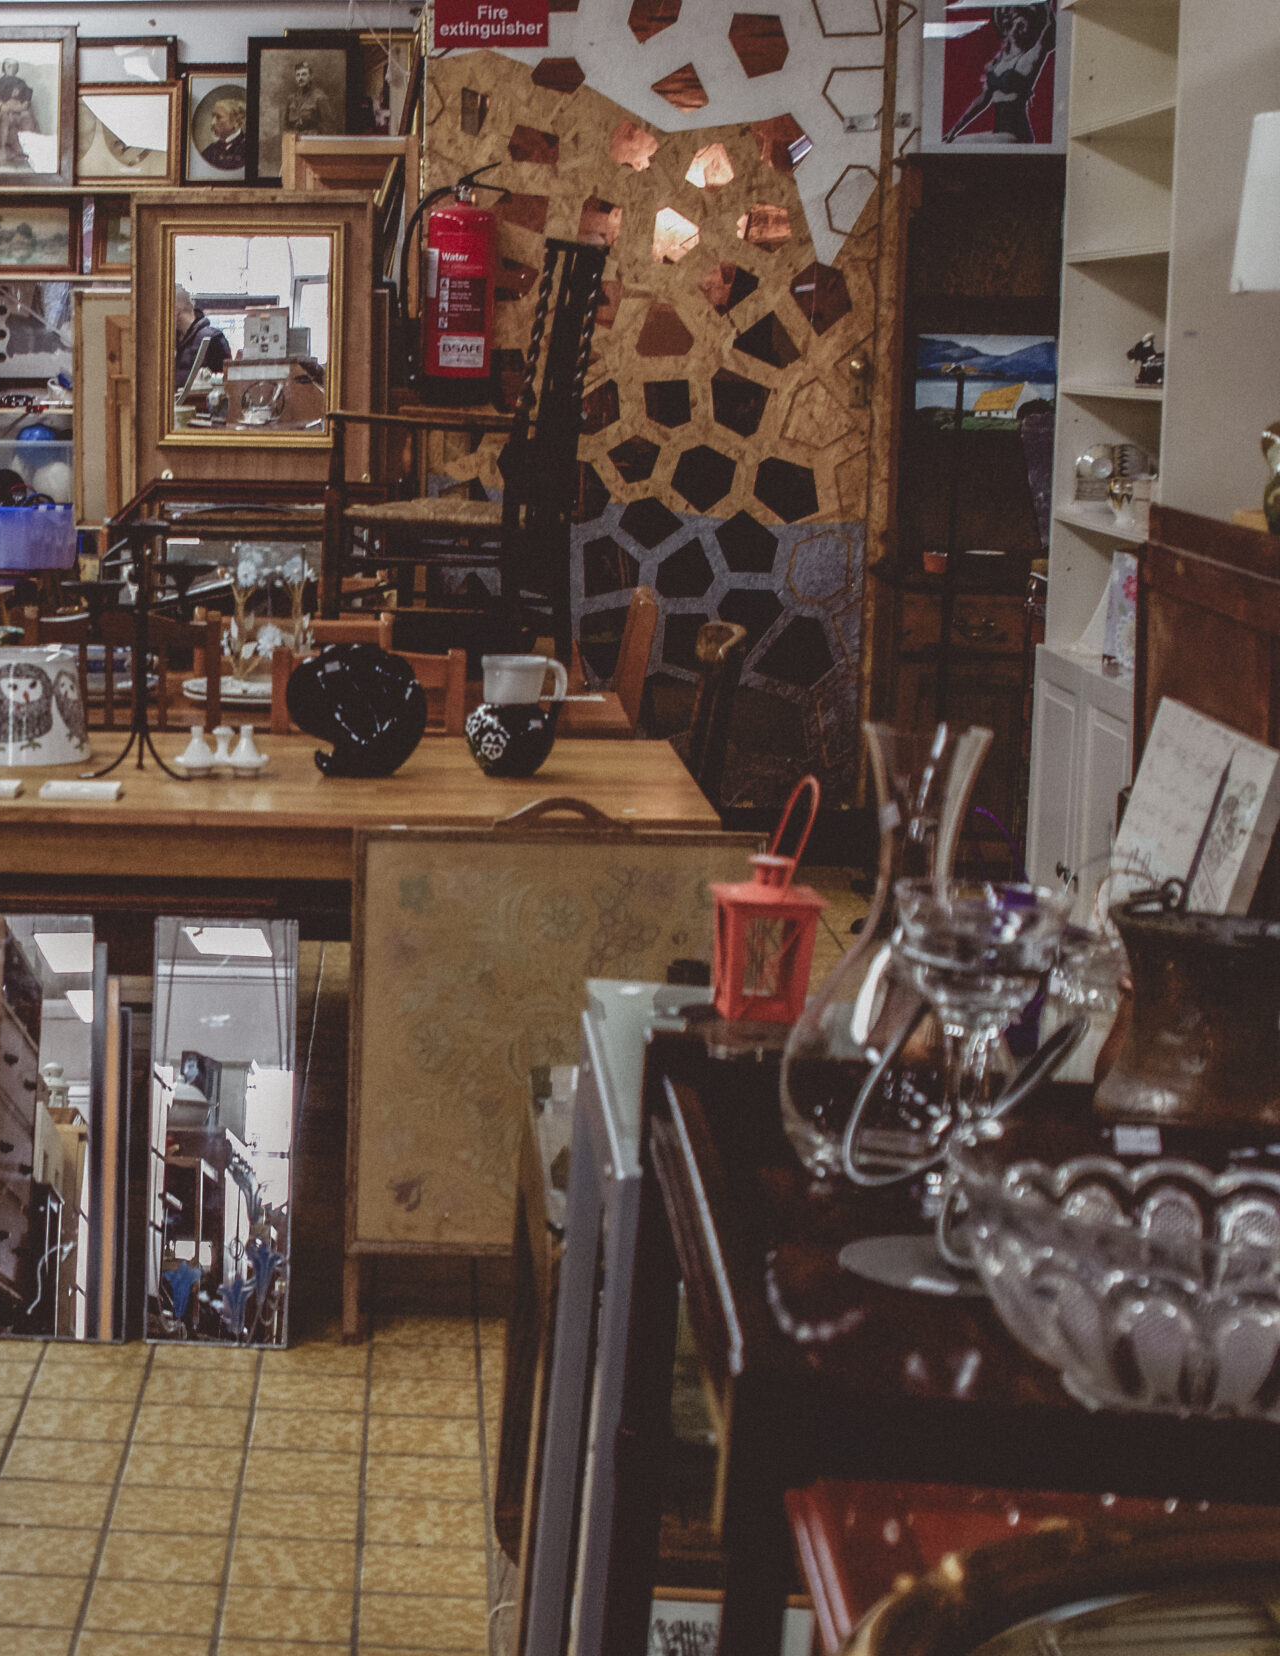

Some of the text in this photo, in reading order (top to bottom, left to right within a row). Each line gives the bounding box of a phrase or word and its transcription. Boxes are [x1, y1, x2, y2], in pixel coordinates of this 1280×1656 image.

[477, 5, 508, 20] Fire
[440, 20, 543, 39] extinguisher
[441, 252, 469, 261] Water
